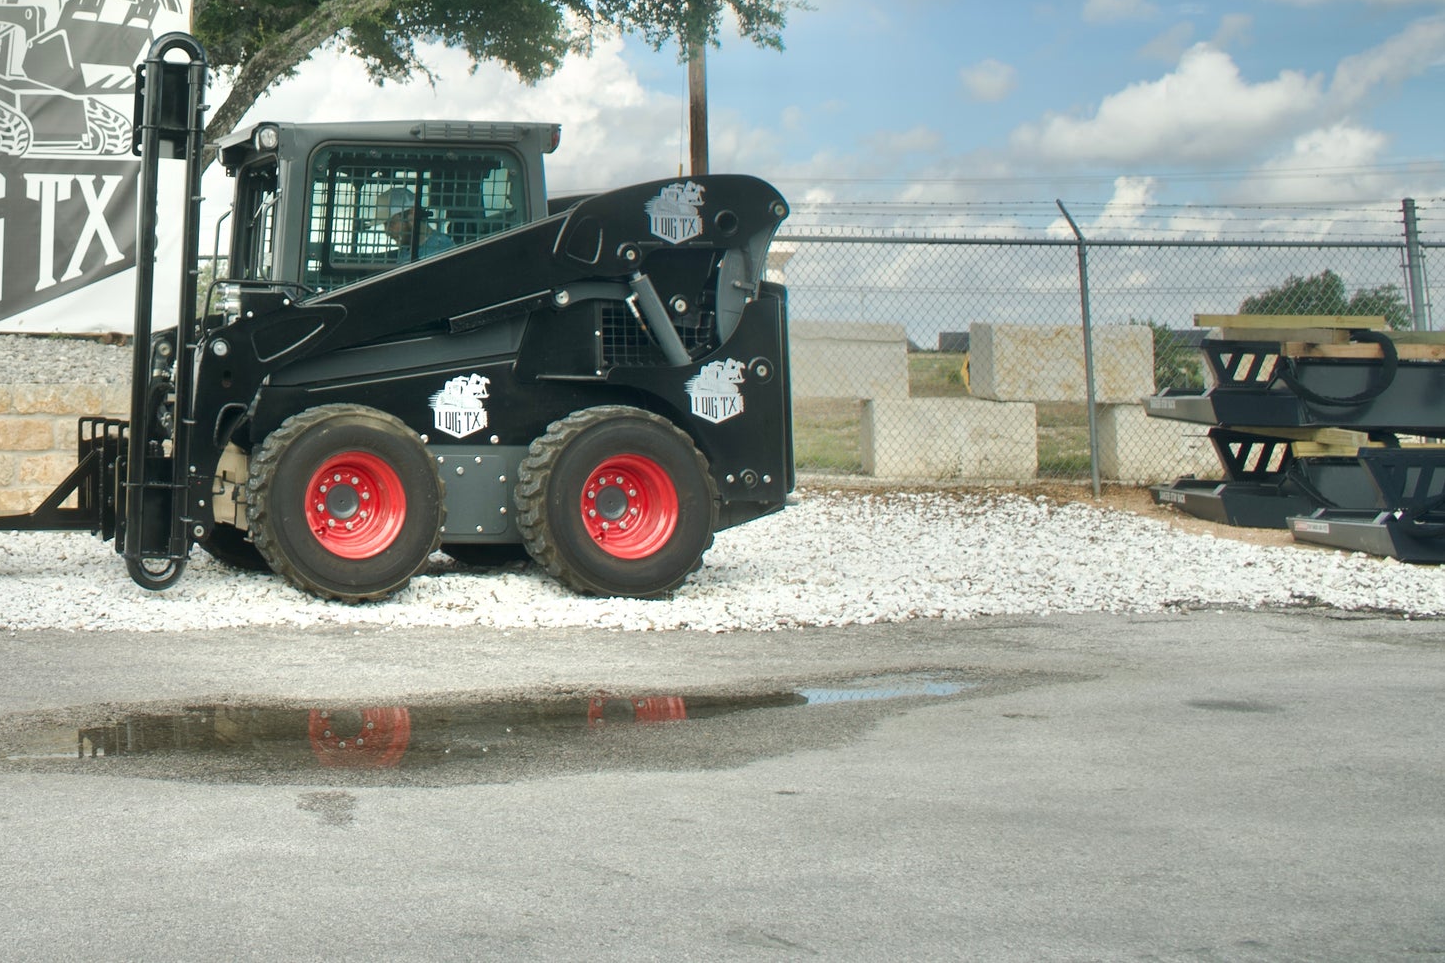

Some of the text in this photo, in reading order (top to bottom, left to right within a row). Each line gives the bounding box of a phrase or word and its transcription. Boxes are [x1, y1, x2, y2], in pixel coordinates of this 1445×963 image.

[22, 172, 126, 292] TX
[661, 217, 677, 240] DIG
[680, 217, 696, 237] TX
[701, 397, 718, 419] DIG
[720, 397, 737, 416] TX
[445, 411, 461, 434] DIG
[464, 411, 481, 431] TX
